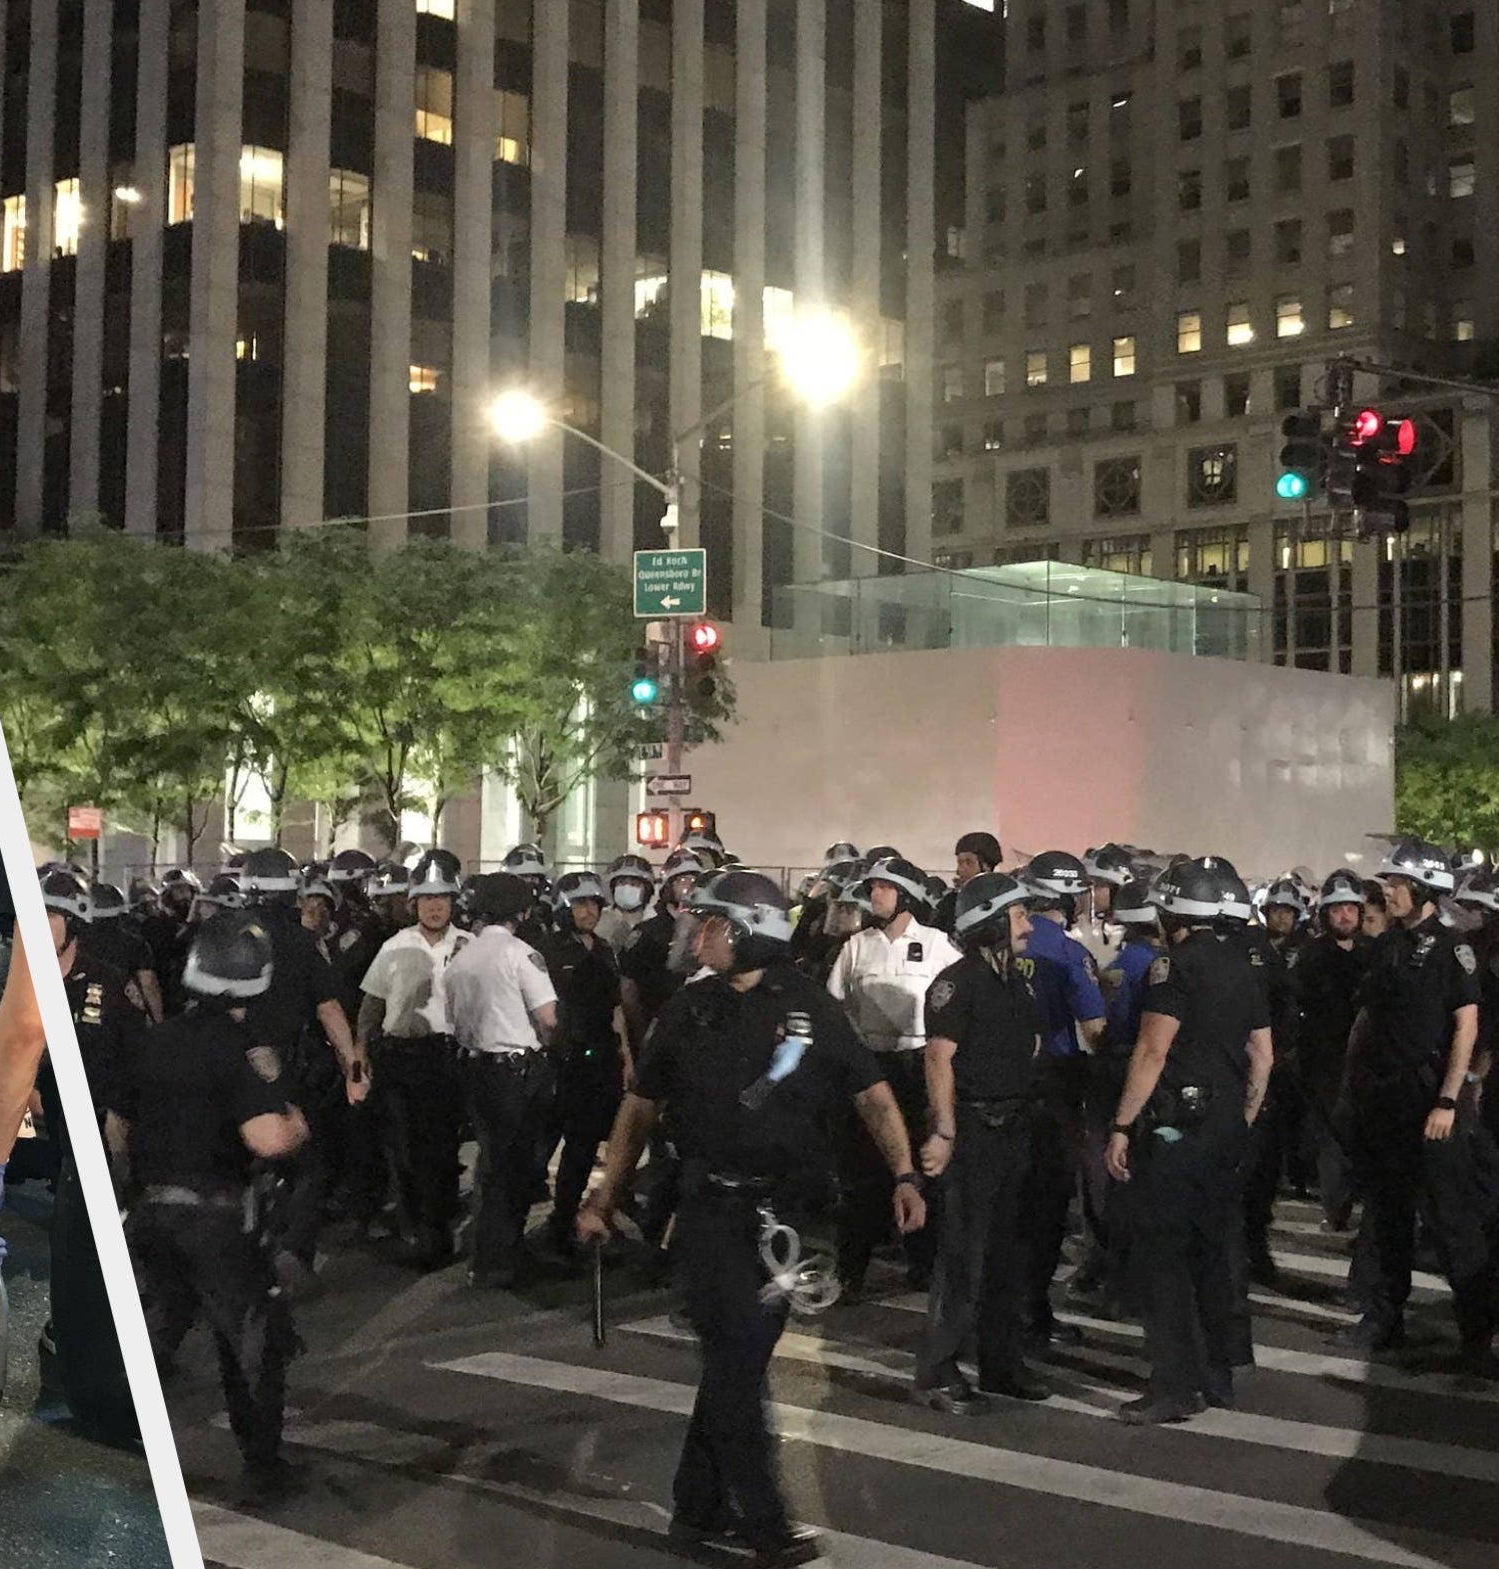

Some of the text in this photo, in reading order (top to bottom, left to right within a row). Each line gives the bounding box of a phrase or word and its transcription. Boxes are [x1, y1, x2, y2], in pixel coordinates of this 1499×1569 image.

[652, 556, 688, 566] Ed Koch
[638, 568, 702, 580] Queensboro Br
[644, 583, 669, 593] Lower
